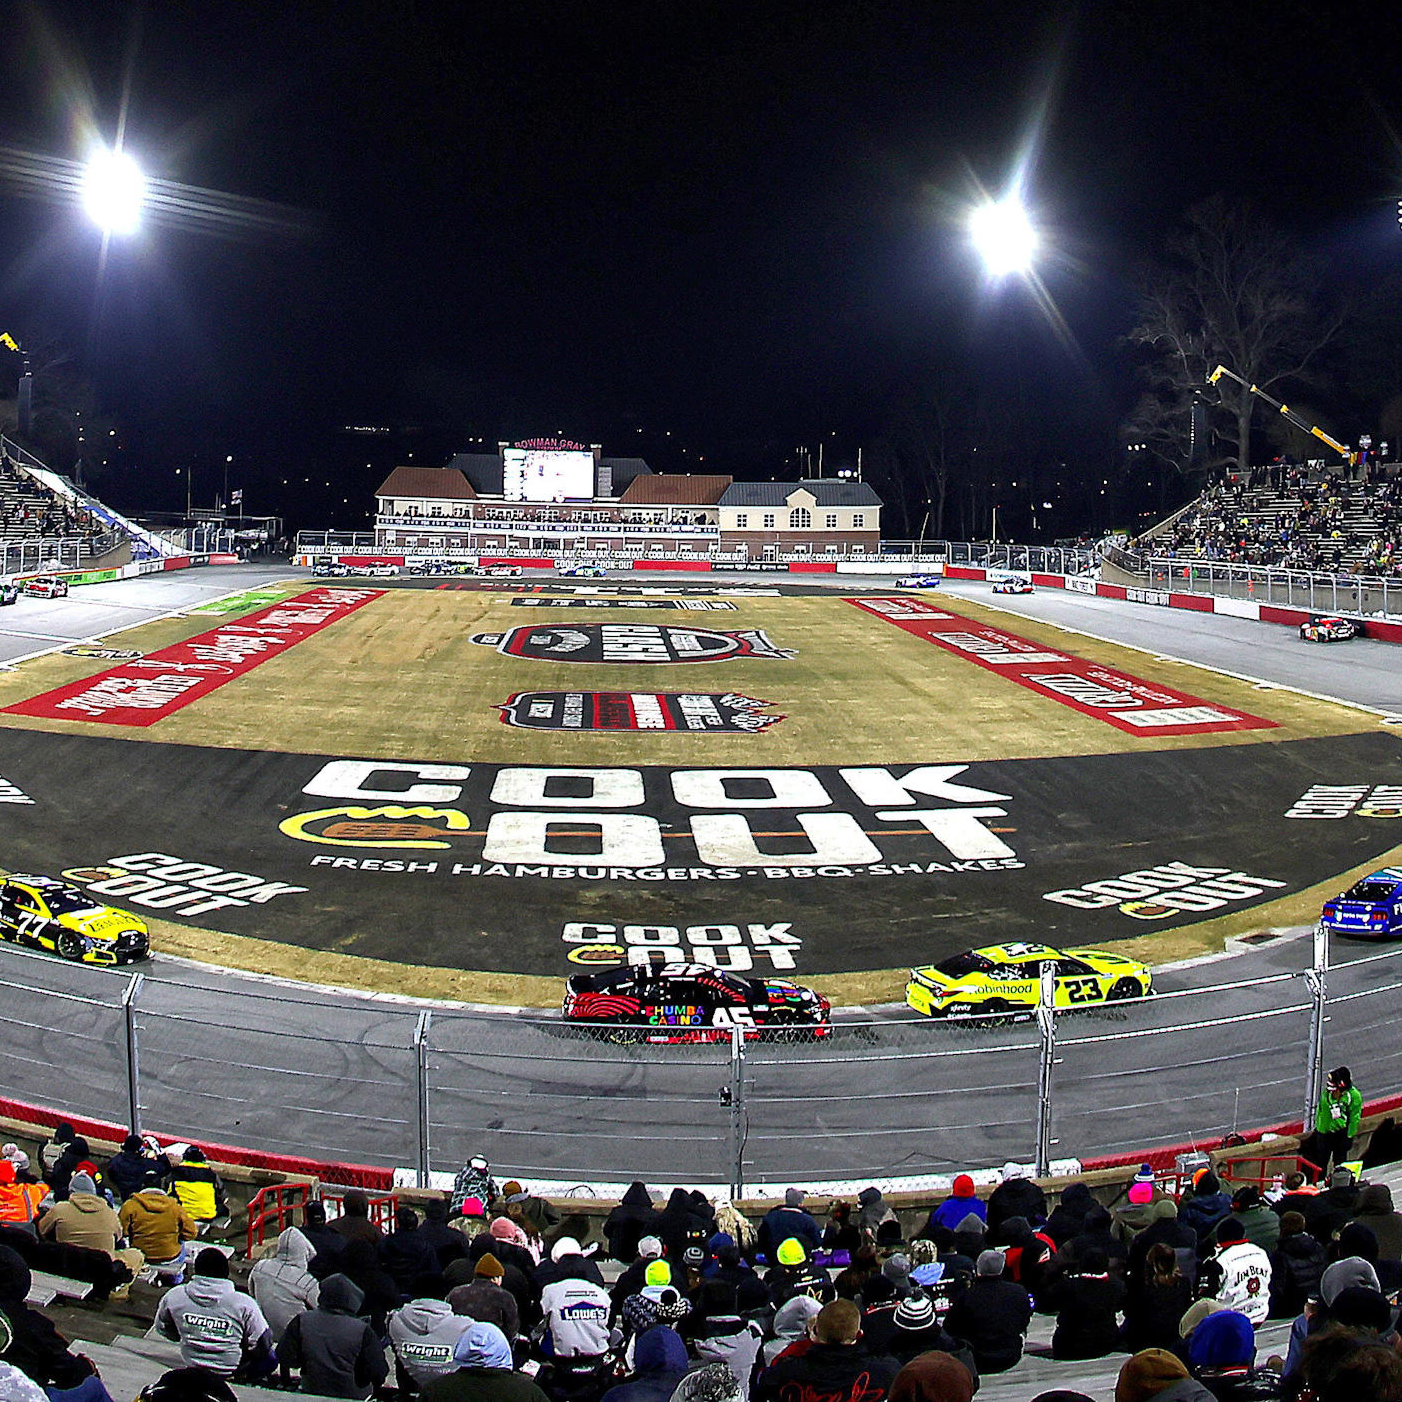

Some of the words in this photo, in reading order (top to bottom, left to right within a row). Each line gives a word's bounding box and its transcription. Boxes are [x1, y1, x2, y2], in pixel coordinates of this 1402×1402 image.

[514, 438, 557, 449] BOWMAN
[559, 439, 586, 450] GRAY
[302, 760, 1013, 809] COOK
[1284, 784, 1370, 819] COOK
[481, 805, 1017, 867] OUT
[106, 852, 309, 904] COOK
[310, 854, 438, 873] FRESH
[453, 862, 741, 882] HAMBURGERS
[763, 865, 855, 880] BBQ
[869, 857, 1026, 877] SHAKES
[85, 873, 250, 917] OUT
[1042, 860, 1231, 909] COOK
[1144, 871, 1287, 912] OUT
[17, 911, 48, 938] 77
[561, 922, 803, 945] COOK
[627, 944, 801, 971] OUT
[1064, 977, 1103, 1004] 23
[645, 1005, 705, 1017] CHUMBA
[648, 1015, 702, 1026] CASINO
[711, 1006, 756, 1028] 45
[186, 1314, 229, 1330] Wright
[405, 1343, 450, 1358] Wright
